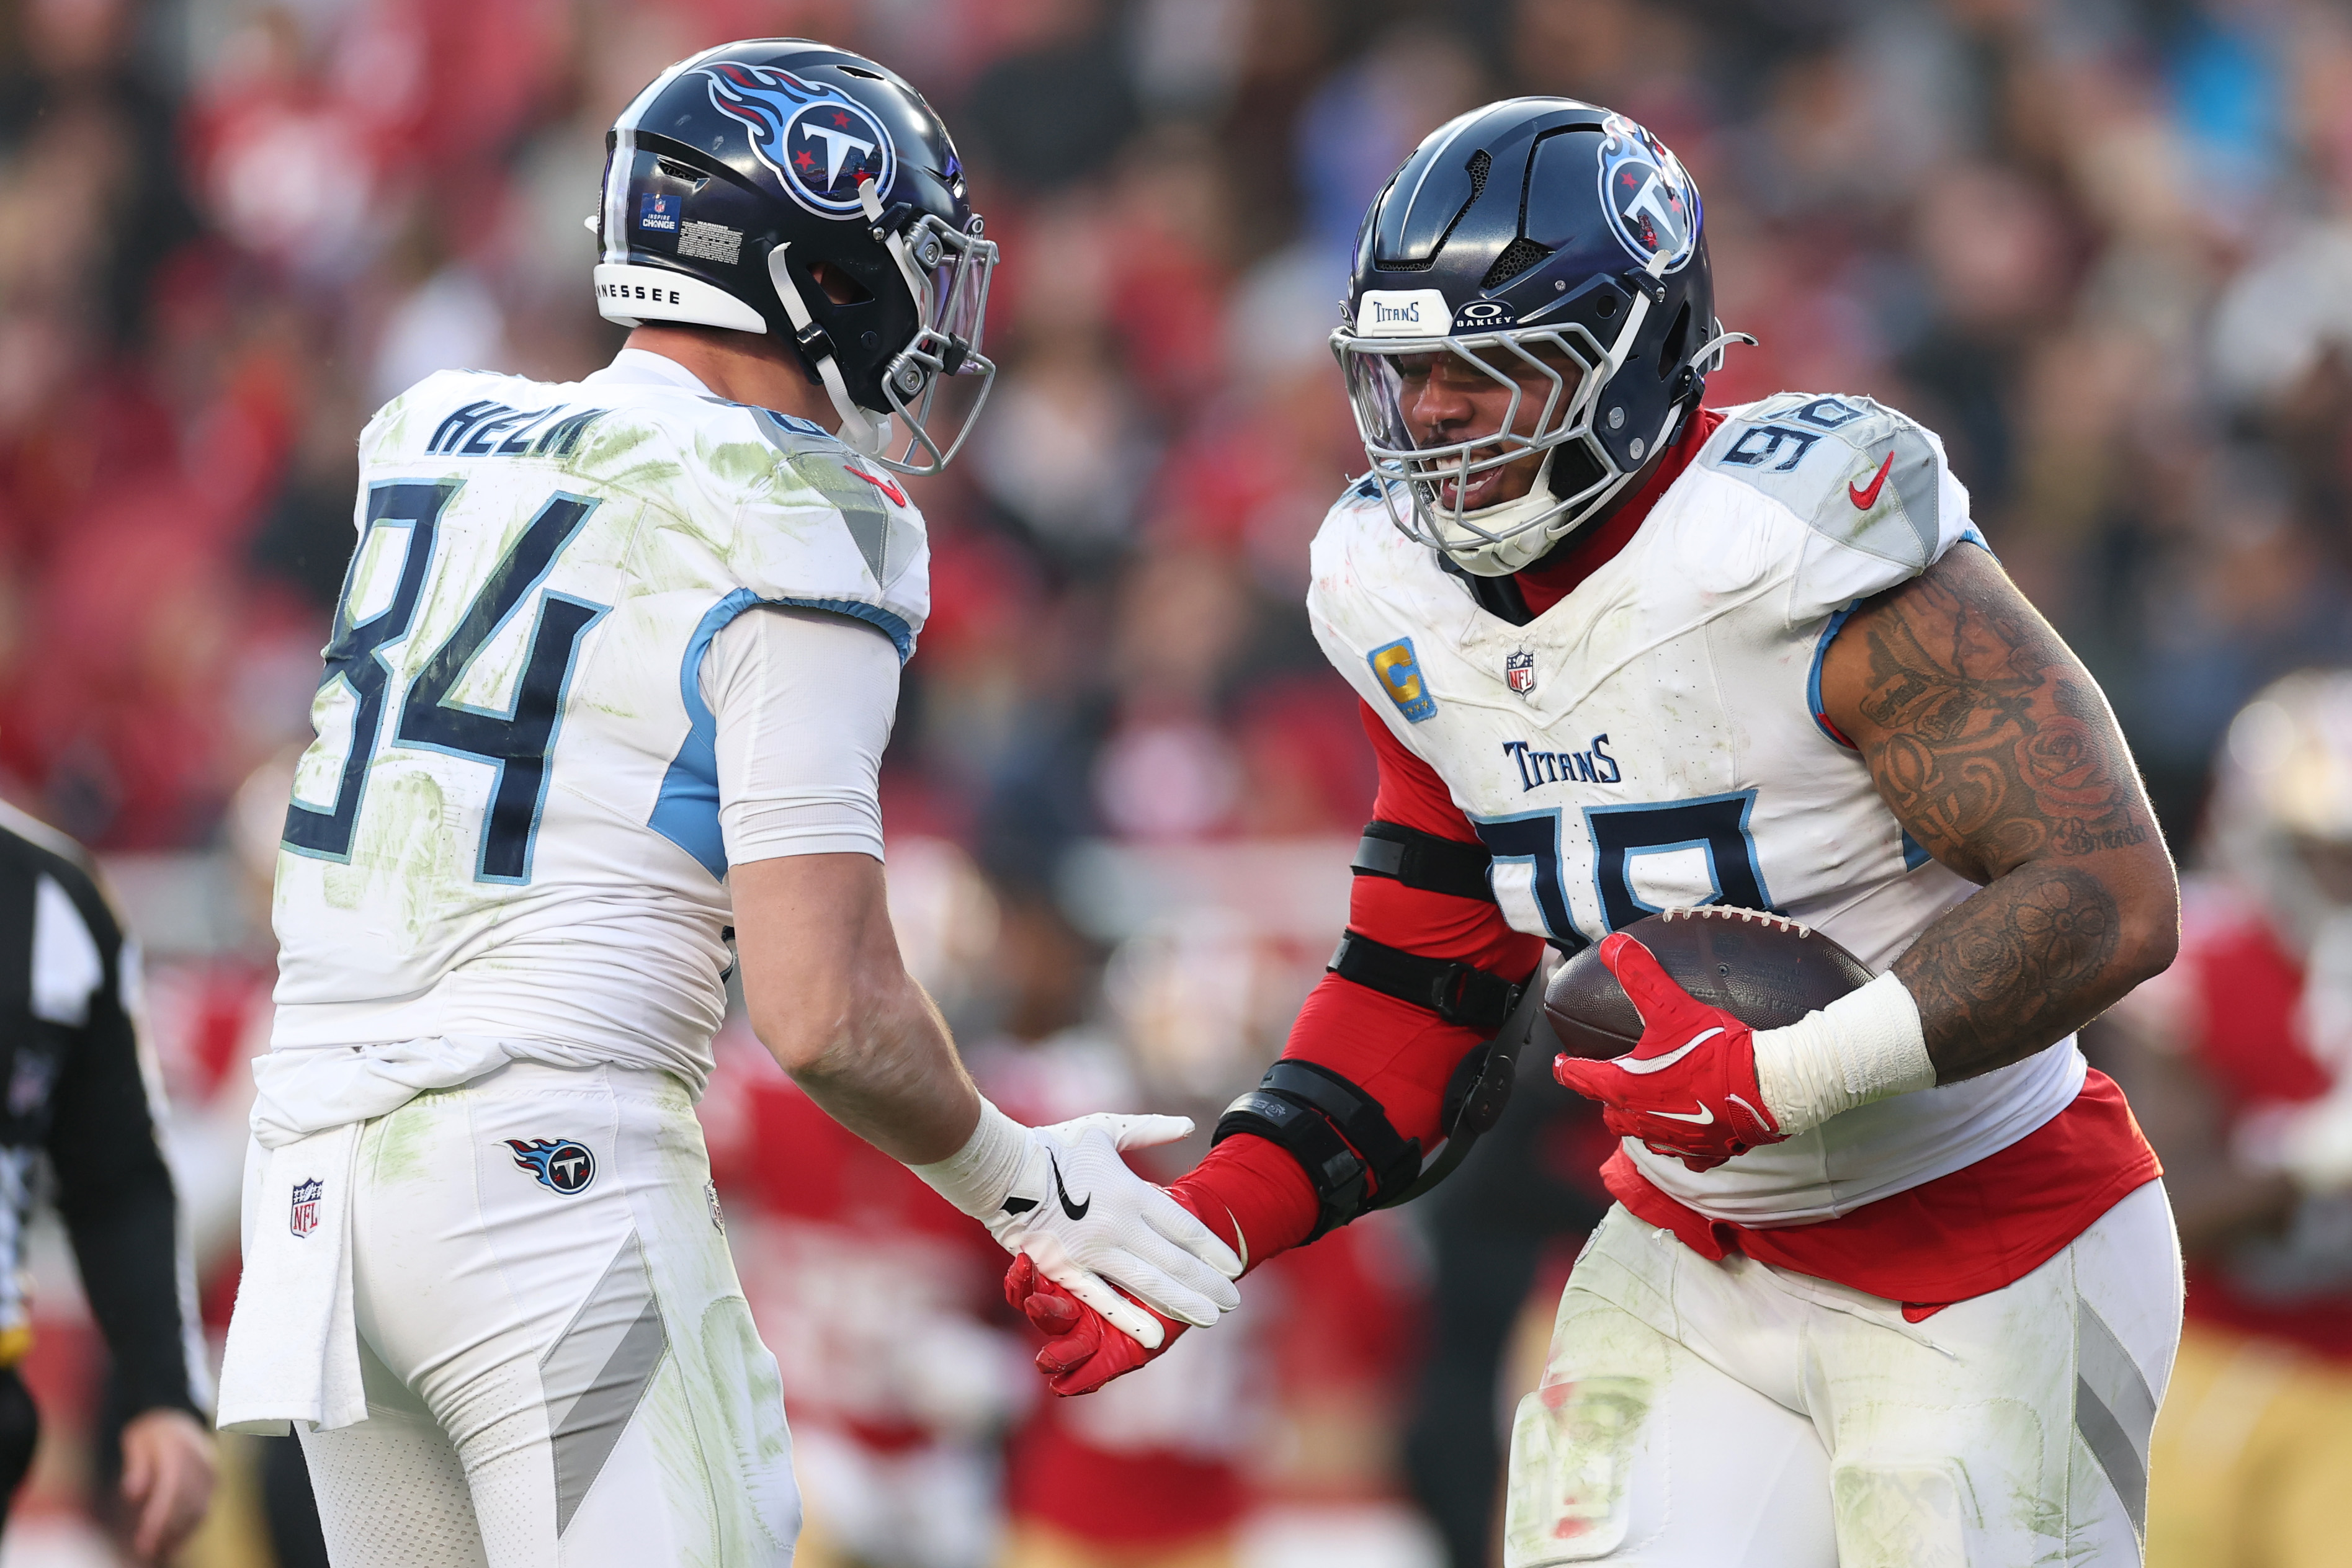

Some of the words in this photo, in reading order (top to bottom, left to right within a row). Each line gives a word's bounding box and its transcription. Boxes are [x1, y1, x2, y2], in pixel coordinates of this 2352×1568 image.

[642, 218, 675, 229] CHANGE
[697, 220, 728, 230] WARNING
[596, 283, 679, 305] NNESSEE
[1373, 301, 1418, 323] TITANS
[1457, 316, 1511, 327] OAKLEY
[424, 399, 620, 458] HELM
[280, 477, 614, 886] 84
[1374, 644, 1421, 704] C
[1509, 669, 1532, 690] NFL
[1502, 733, 1621, 793] TITANS
[293, 1202, 318, 1232] NFL
